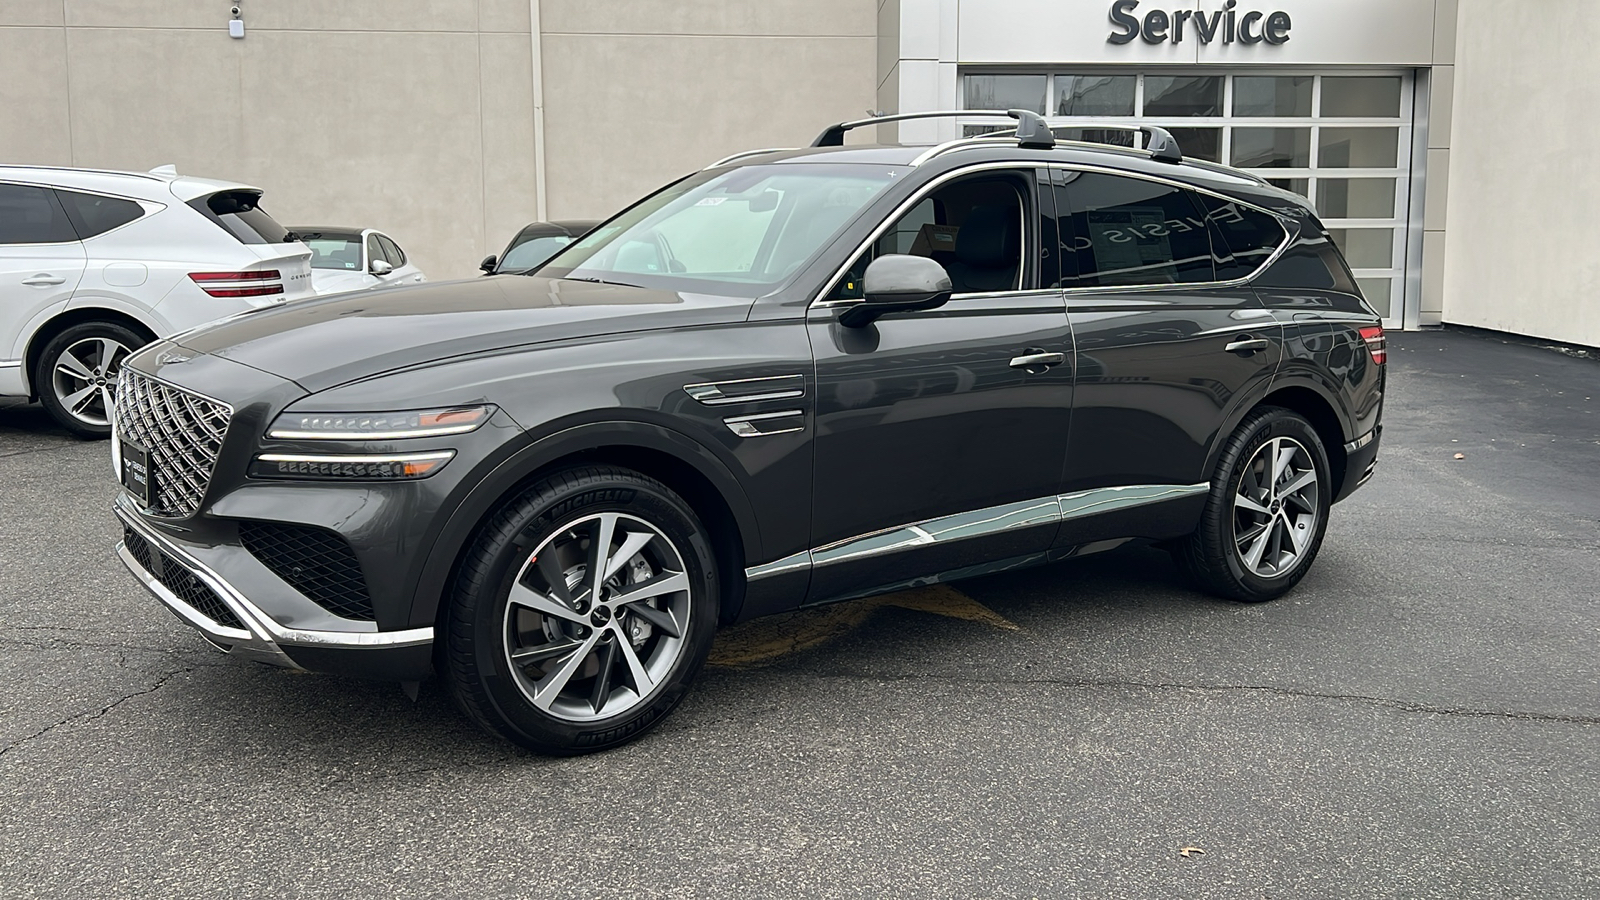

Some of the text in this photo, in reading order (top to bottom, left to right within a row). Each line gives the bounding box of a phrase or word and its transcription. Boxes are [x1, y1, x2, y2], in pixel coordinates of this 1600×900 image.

[1107, 0, 1292, 45] Service
[551, 490, 635, 518] MICHELIN
[577, 708, 655, 746] MICHELIN
